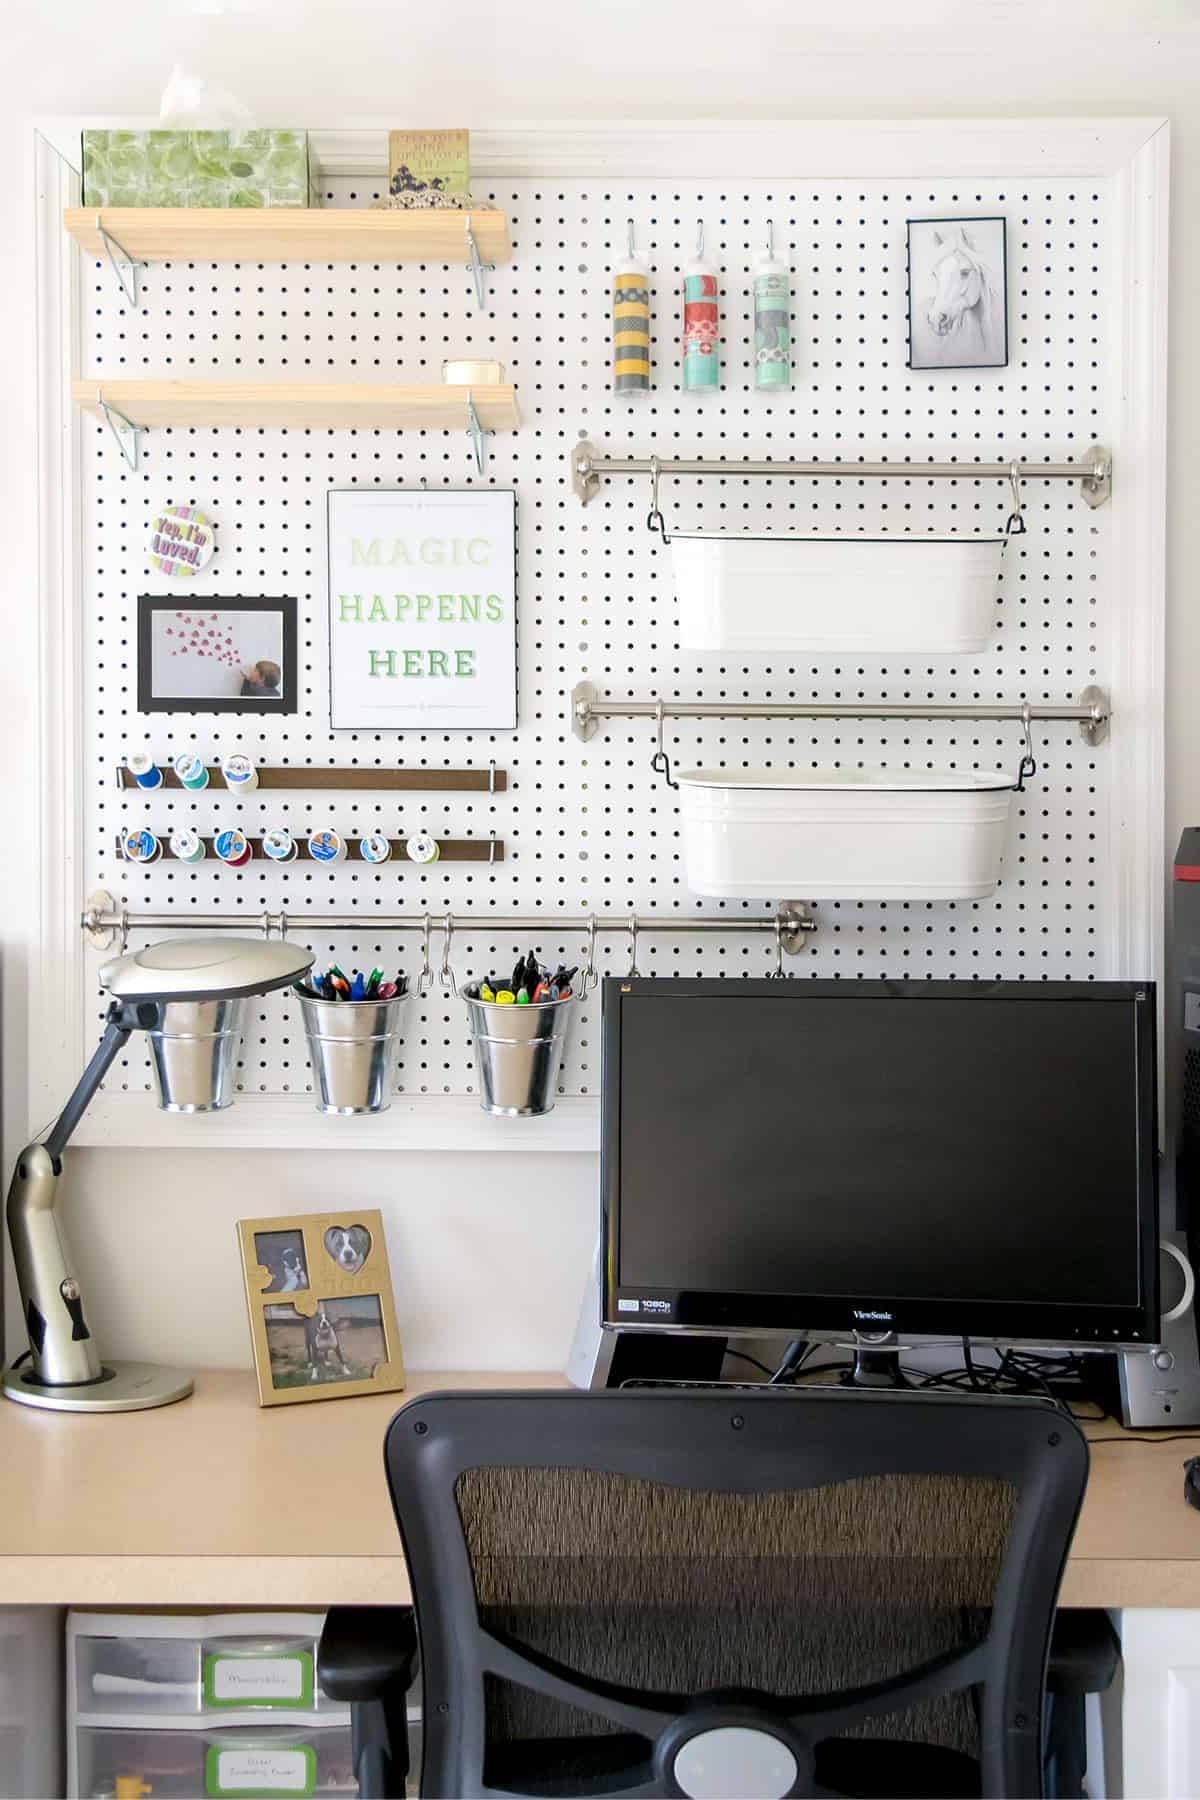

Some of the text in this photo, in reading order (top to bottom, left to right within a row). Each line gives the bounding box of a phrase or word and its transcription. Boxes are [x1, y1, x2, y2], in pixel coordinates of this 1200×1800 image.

[158, 518, 206, 546] Yep, I'm
[153, 534, 200, 567] Loved.
[351, 537, 491, 567] MAGIC
[338, 594, 504, 622] HAPPENS
[368, 650, 475, 677] HERE
[853, 1310, 893, 1320] ViewSonic
